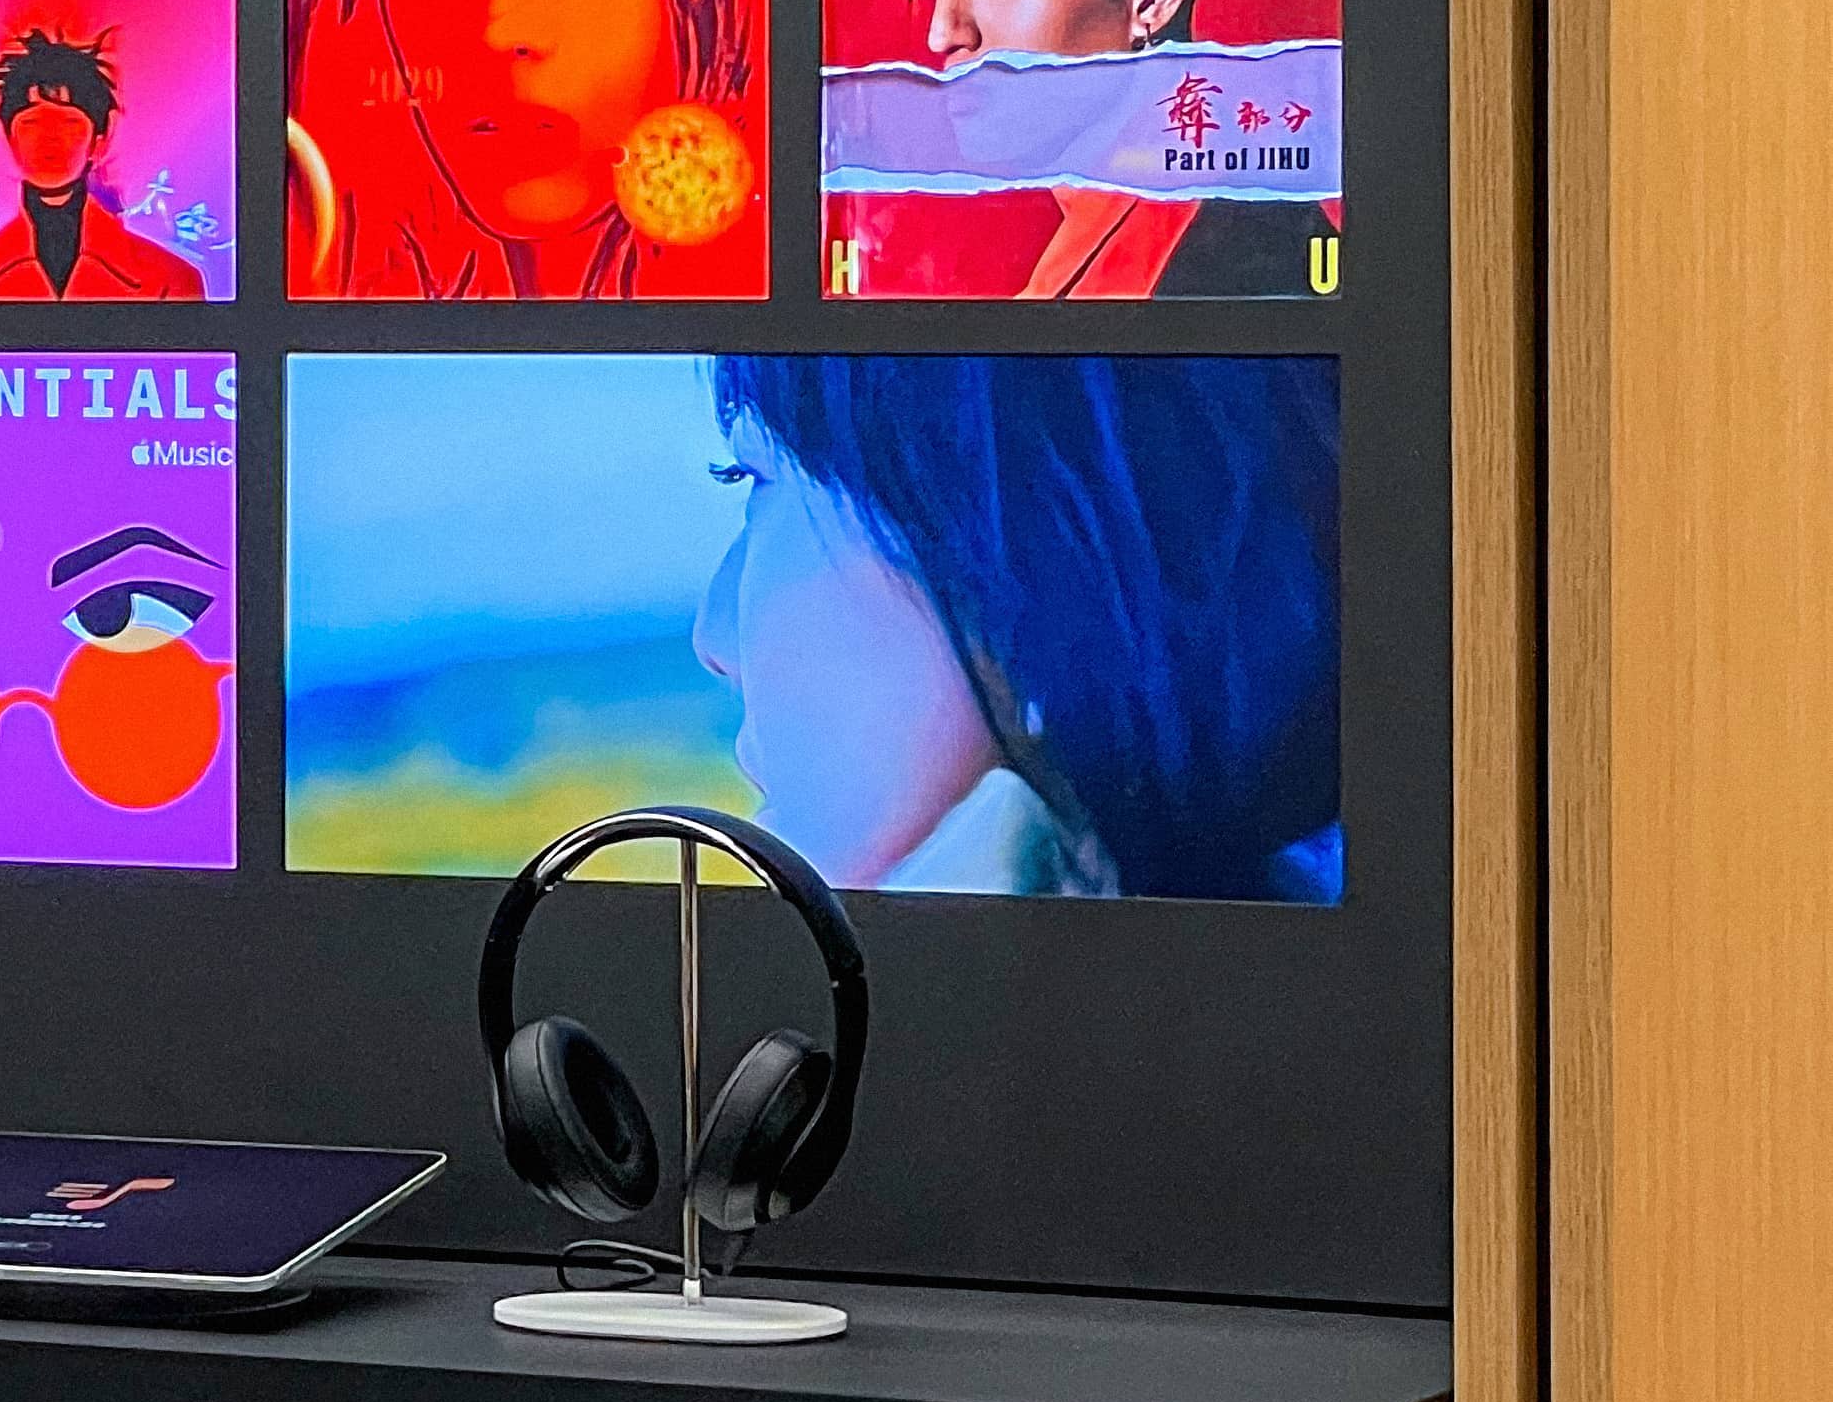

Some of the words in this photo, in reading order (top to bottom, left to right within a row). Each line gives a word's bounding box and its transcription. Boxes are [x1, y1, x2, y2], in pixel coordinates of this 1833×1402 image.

[1164, 148, 1216, 170] Part
[1225, 147, 1248, 170] of
[1257, 146, 1310, 170] JIHU
[1309, 236, 1340, 295] U
[153, 440, 233, 467] Music
